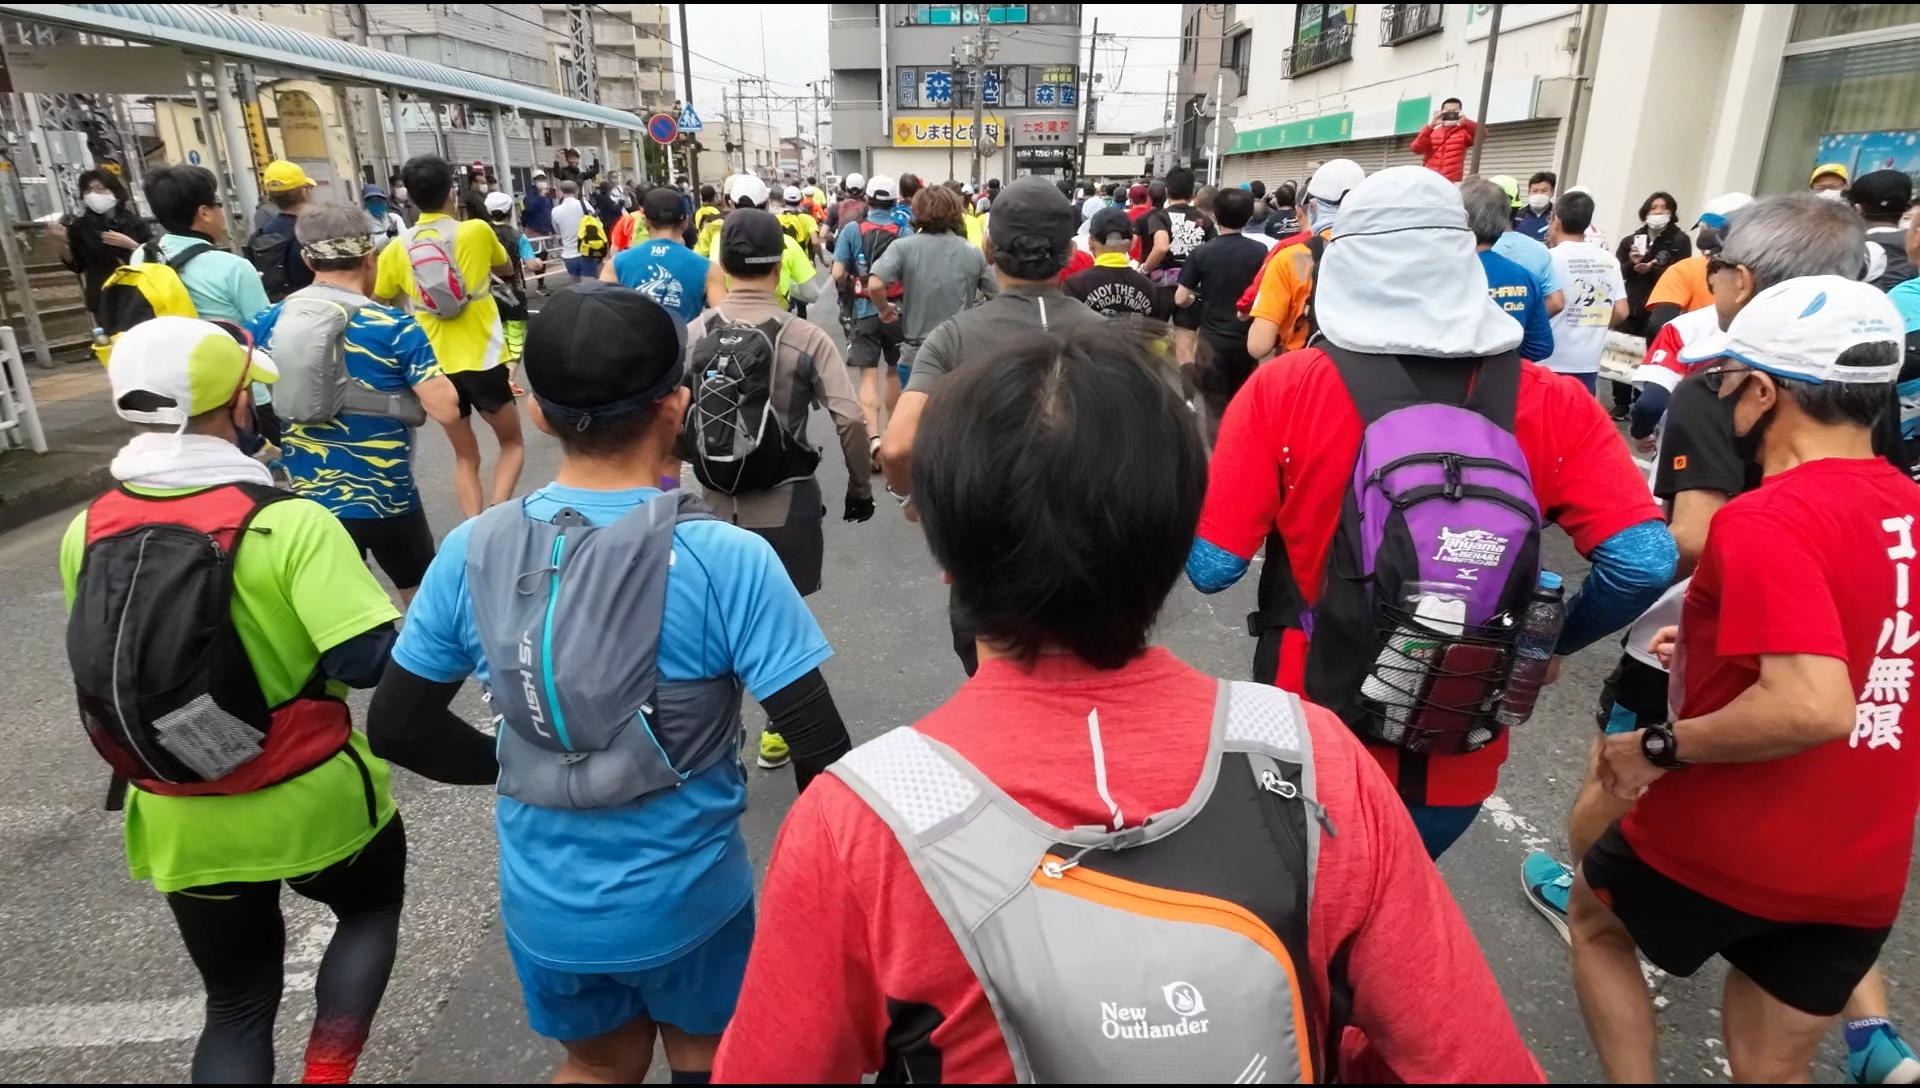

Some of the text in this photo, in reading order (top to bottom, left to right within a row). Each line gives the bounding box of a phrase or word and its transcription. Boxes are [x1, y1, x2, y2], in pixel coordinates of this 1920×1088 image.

[914, 123, 999, 142] しまもと科
[1023, 119, 1070, 132] 土地建物
[1114, 283, 1135, 298] THE
[1124, 295, 1142, 311] TRIP
[1848, 514, 1920, 751] ゴール無限
[1100, 1001, 1146, 1021] New
[1101, 1017, 1209, 1039] Outlander
